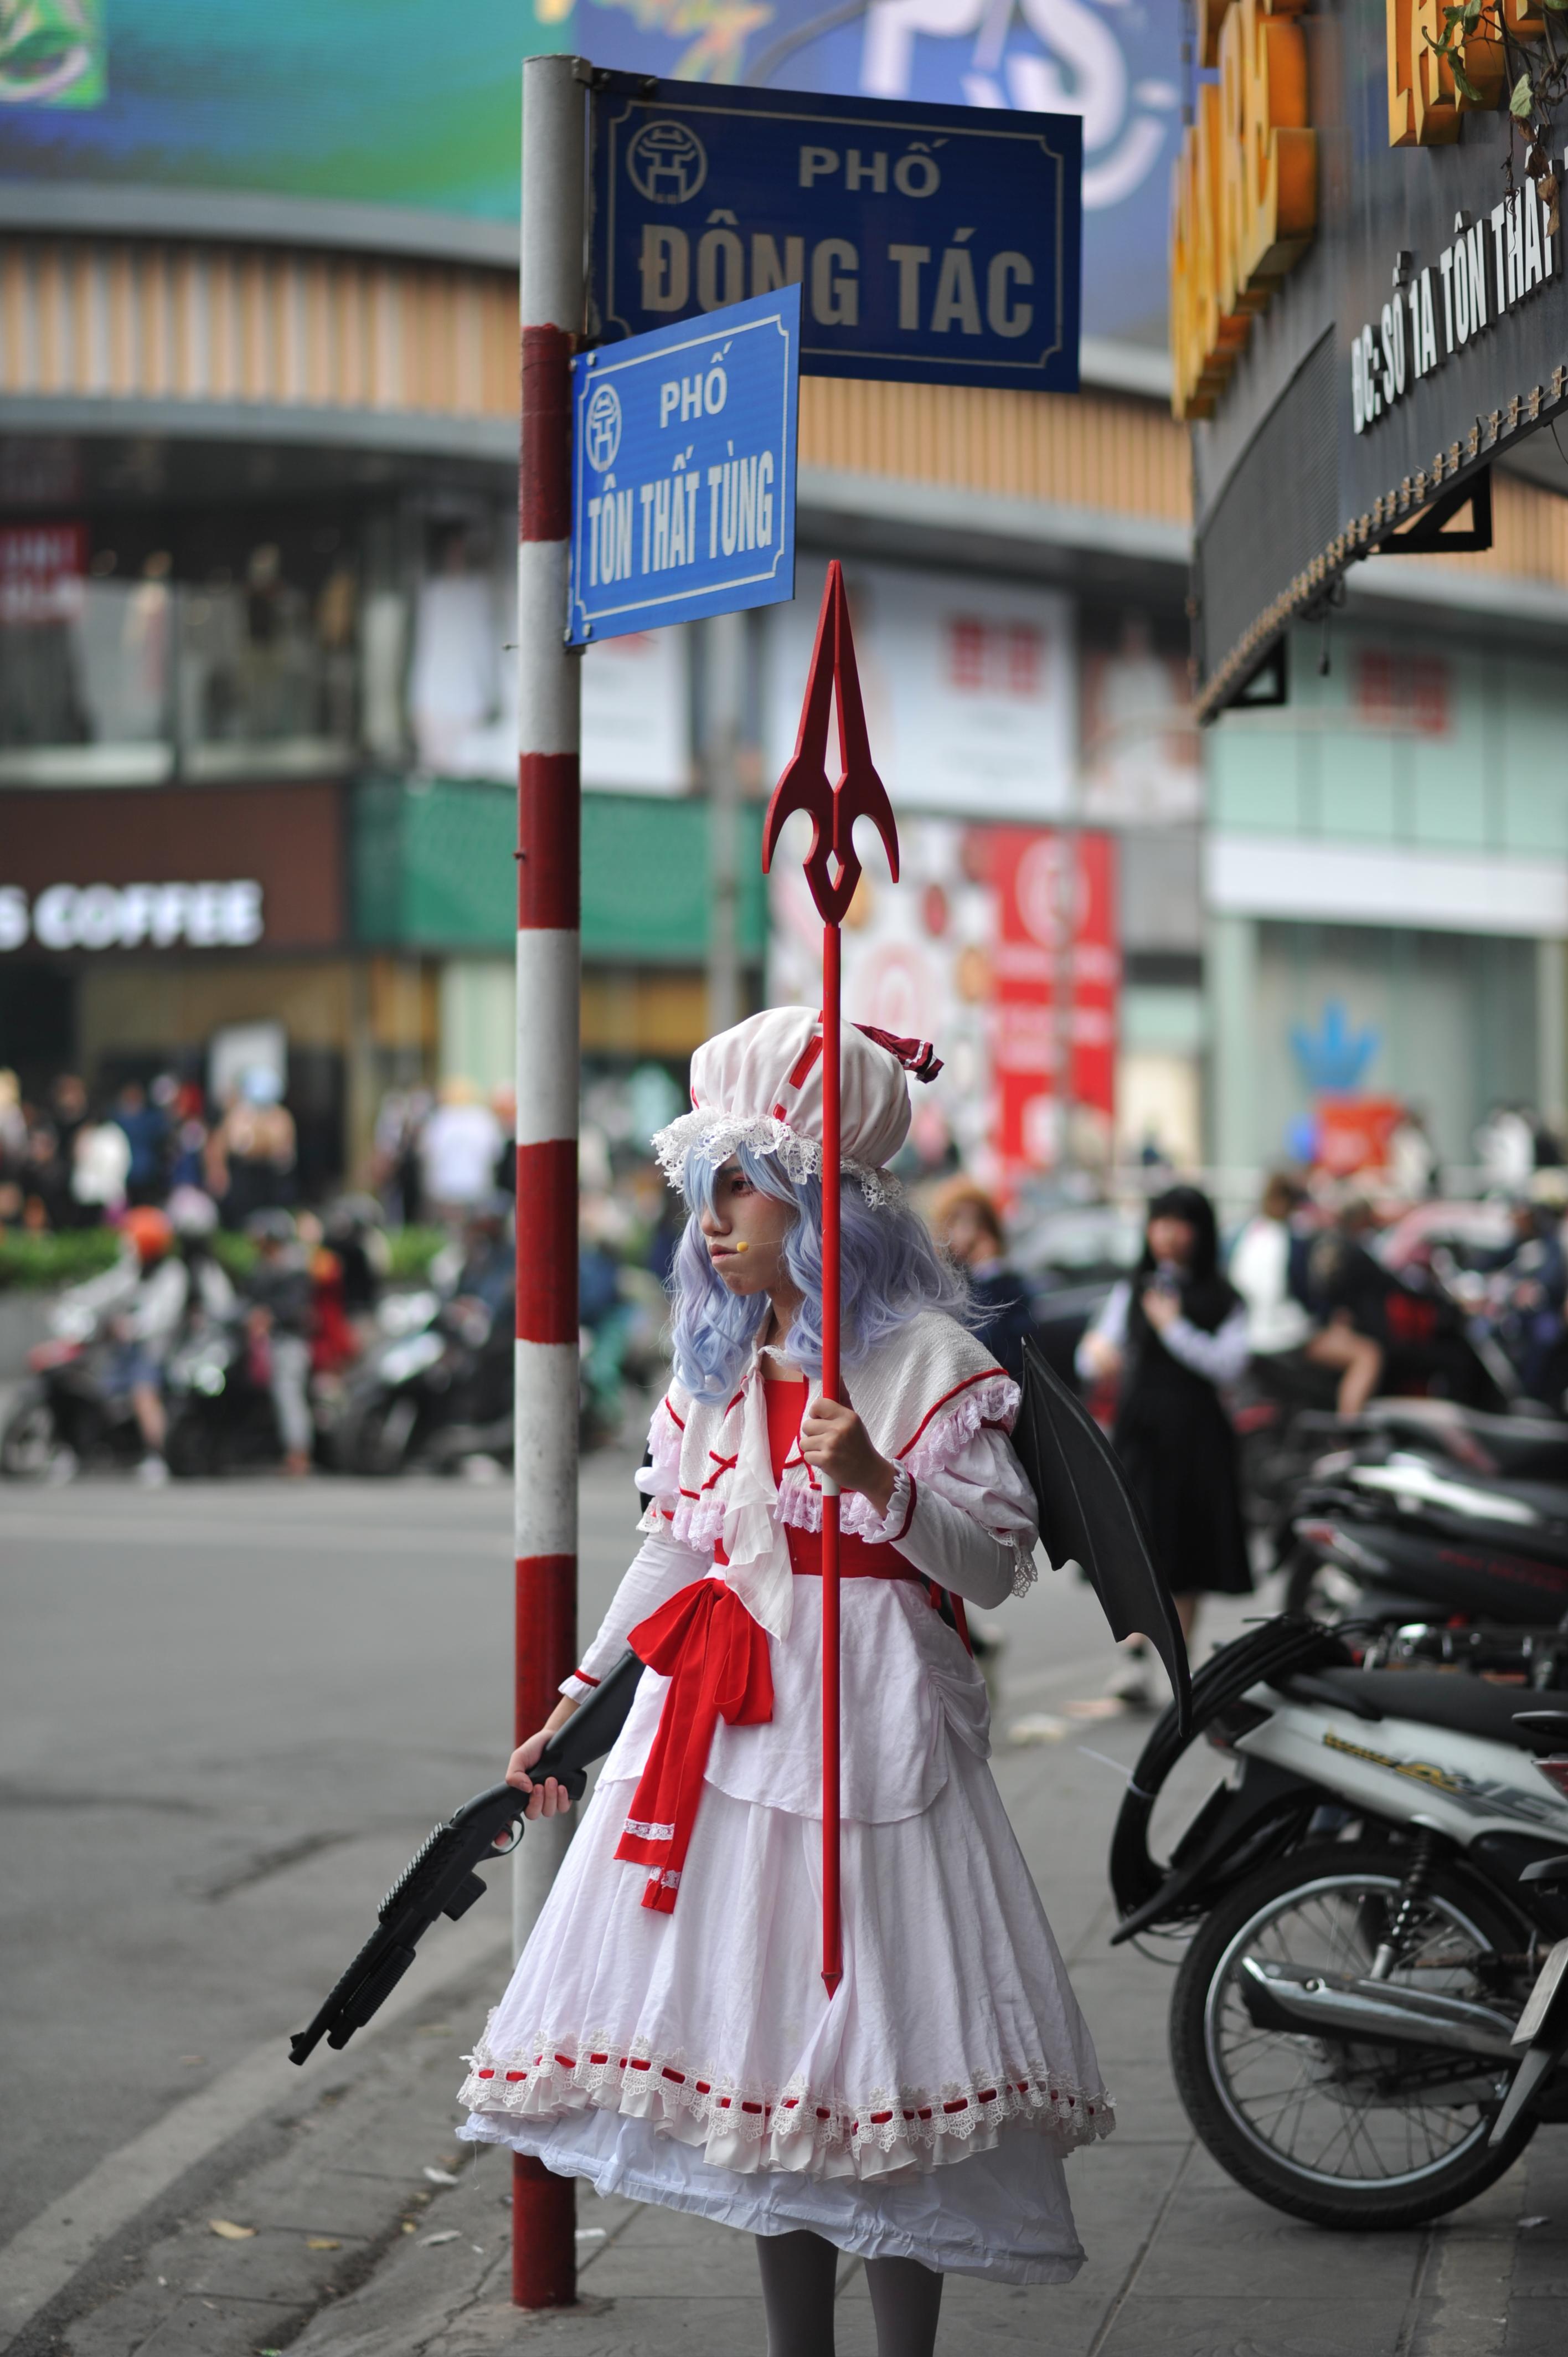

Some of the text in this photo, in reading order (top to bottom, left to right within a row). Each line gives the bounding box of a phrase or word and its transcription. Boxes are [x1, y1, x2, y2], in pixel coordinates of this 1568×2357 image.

[798, 137, 950, 198] PHỐ
[638, 208, 1035, 338] ĐÔNG TÁC
[1409, 266, 1438, 379] 1A
[1440, 210, 1488, 354] TÔN
[659, 340, 734, 429] PHỐ
[588, 439, 775, 588] TÔN THẤT TÙNG
[33, 878, 264, 951] COFFEE
